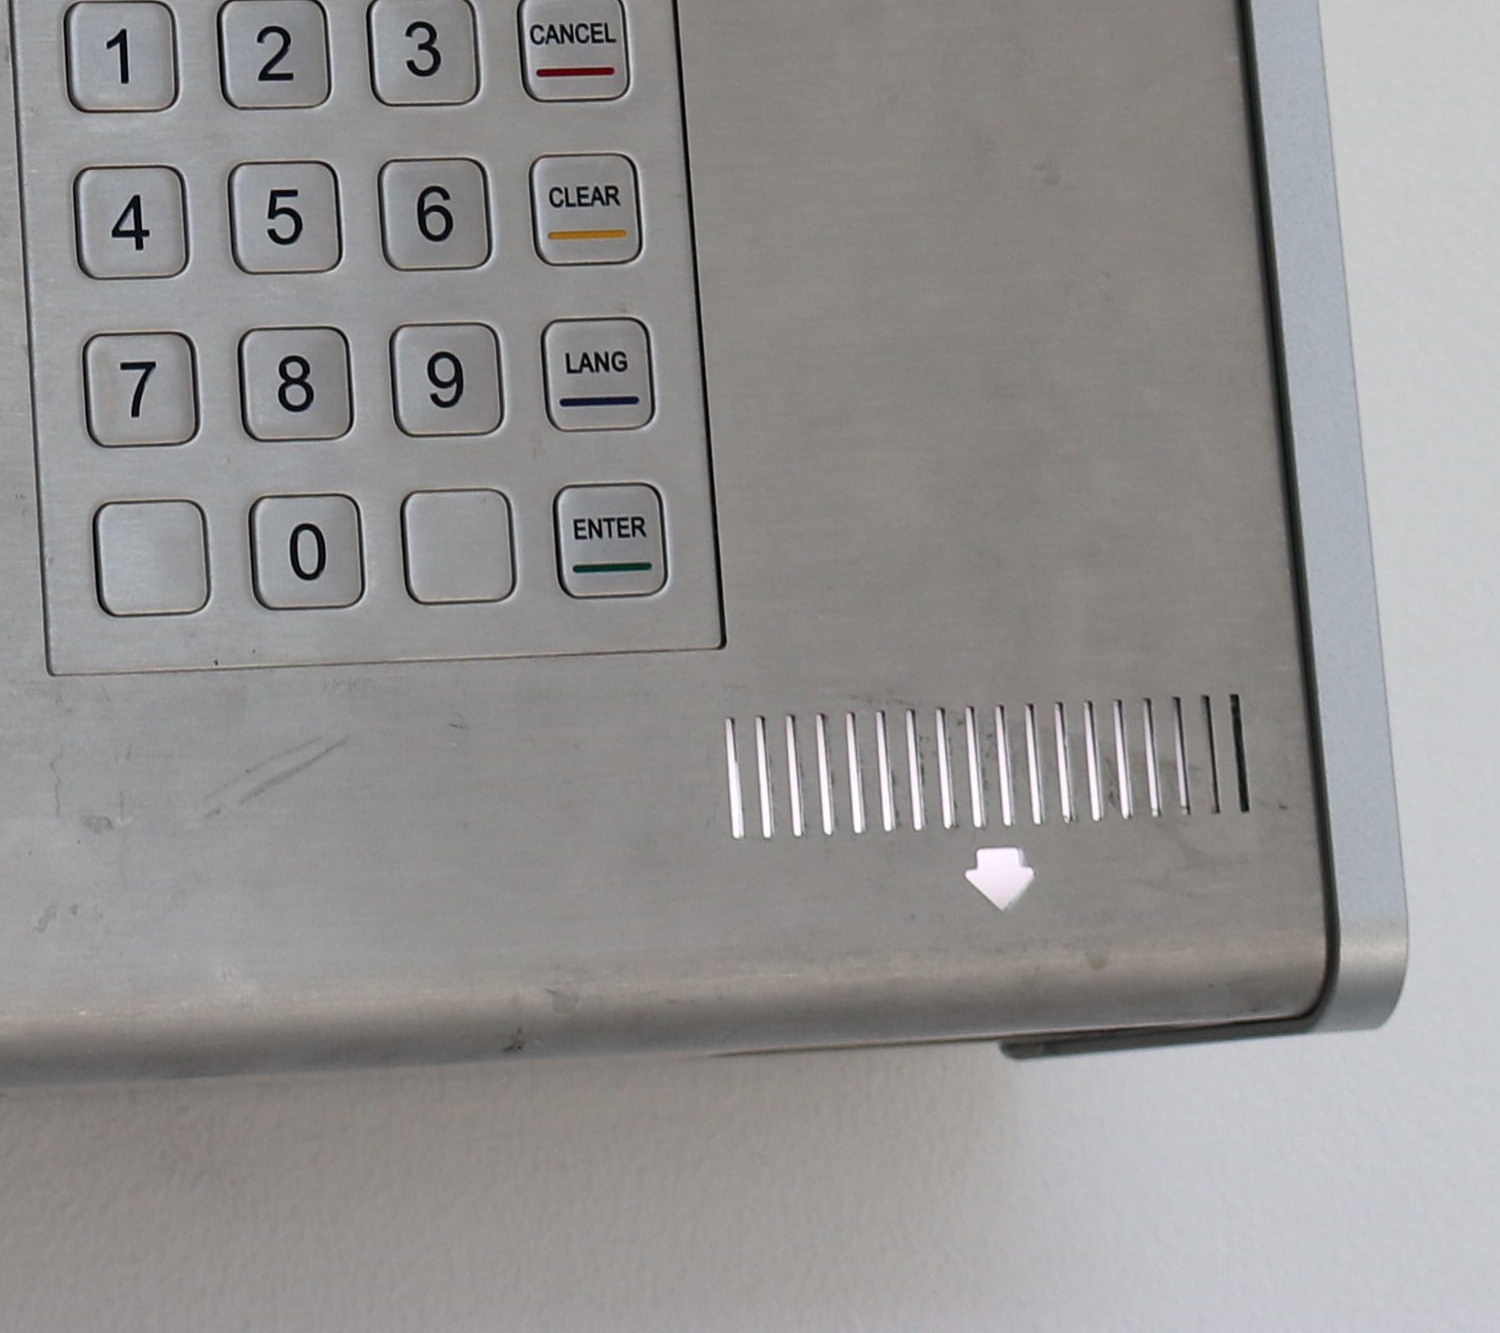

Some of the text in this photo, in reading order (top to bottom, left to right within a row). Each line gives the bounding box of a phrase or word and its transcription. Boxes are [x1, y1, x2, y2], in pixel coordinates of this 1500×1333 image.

[107, 29, 129, 84] 1
[257, 26, 293, 81] 2
[406, 22, 441, 77] 3
[530, 23, 616, 45] CANCEL
[112, 195, 149, 250] 4
[268, 190, 302, 245] 5
[417, 186, 453, 242] 6
[549, 186, 620, 208] CLEAR
[120, 362, 156, 417] 7
[278, 356, 314, 412] 8
[427, 352, 463, 408] 9
[566, 351, 627, 373] LANG
[290, 524, 326, 580] 0
[574, 517, 647, 540] ENTER
